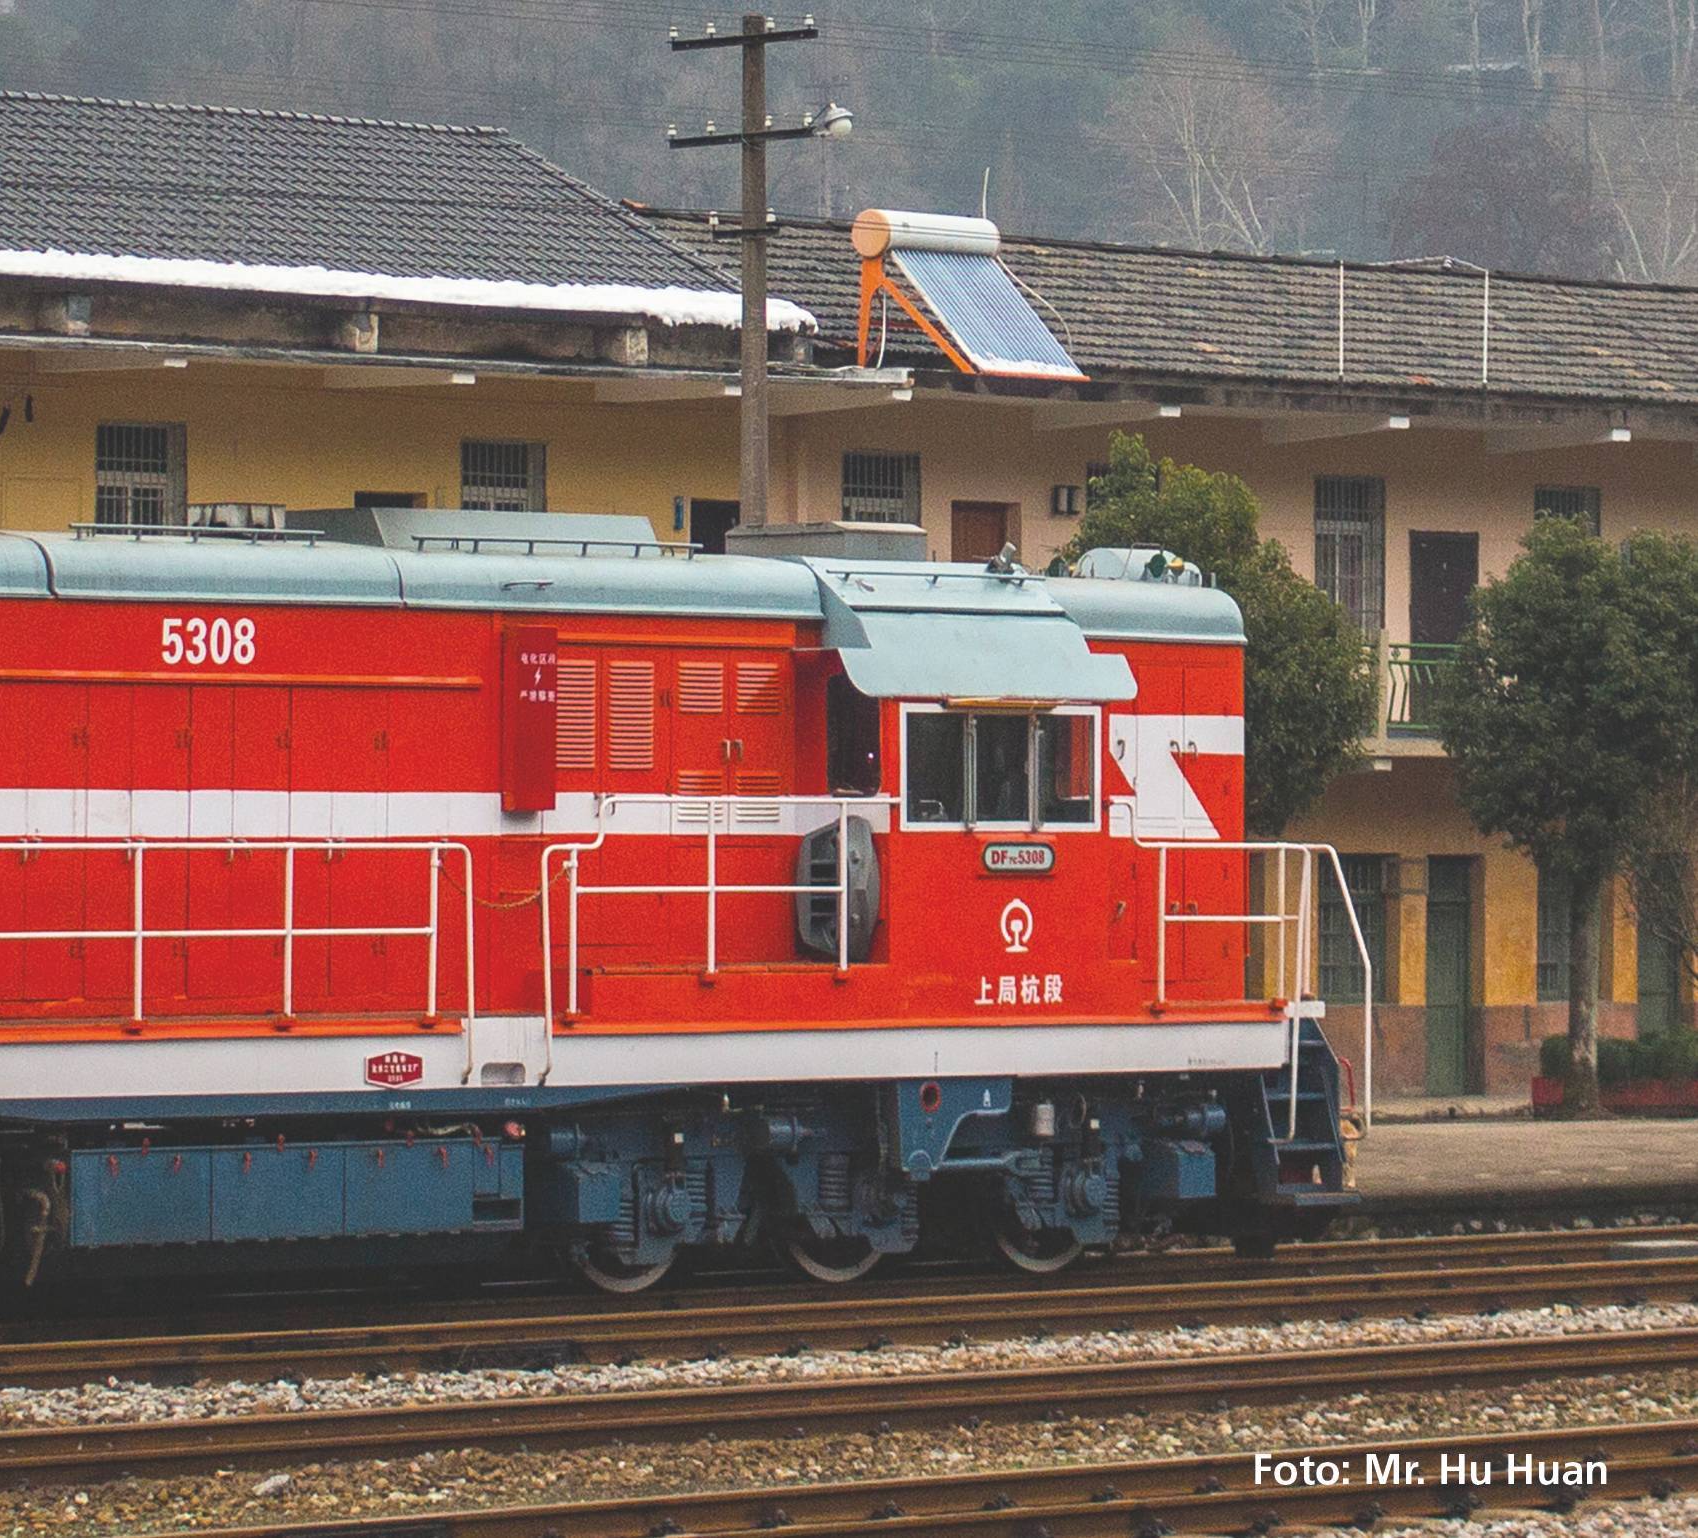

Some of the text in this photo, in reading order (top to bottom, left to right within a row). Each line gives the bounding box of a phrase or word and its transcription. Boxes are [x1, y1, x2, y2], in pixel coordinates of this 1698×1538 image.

[162, 617, 255, 664] 5308
[974, 974, 1063, 1005] 上局杭段
